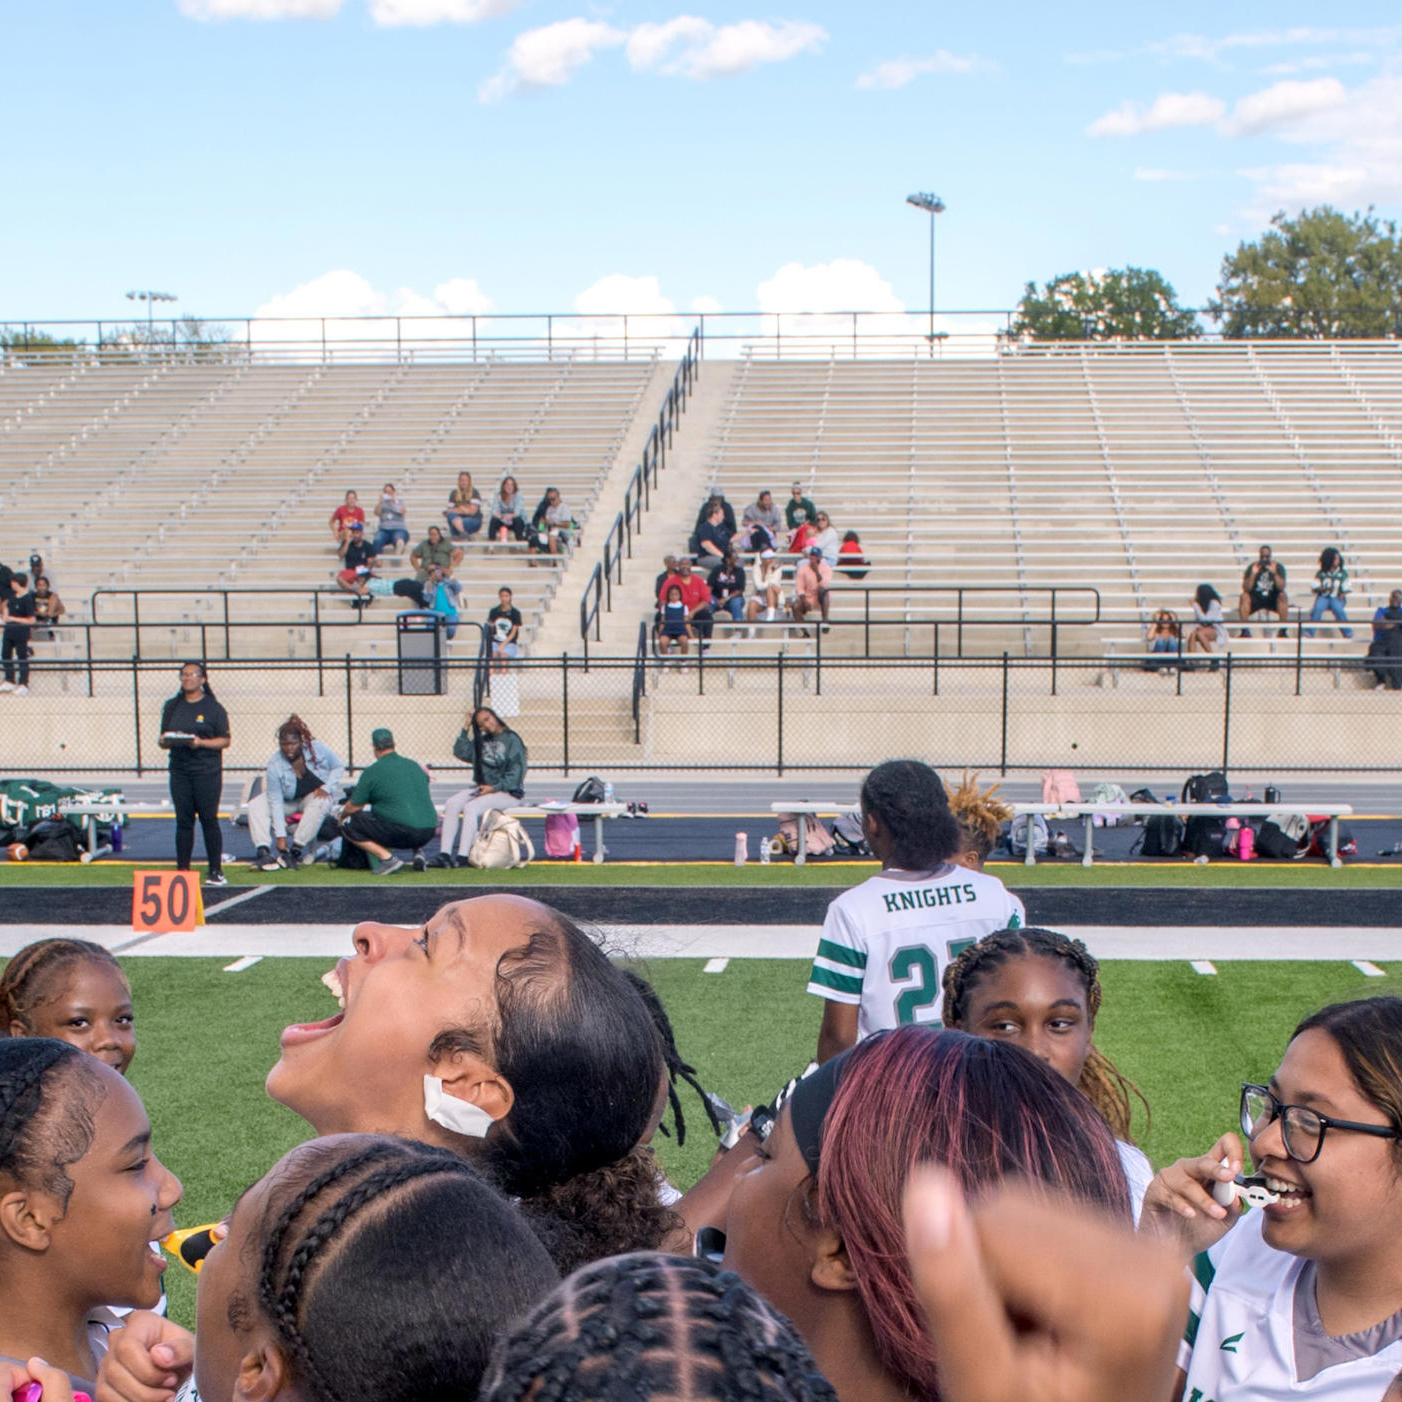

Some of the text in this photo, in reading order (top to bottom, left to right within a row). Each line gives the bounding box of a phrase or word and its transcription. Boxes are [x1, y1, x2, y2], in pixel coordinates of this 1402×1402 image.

[140, 874, 189, 926] 50
[882, 884, 977, 912] KNIGHTS
[887, 936, 978, 1028] 2
